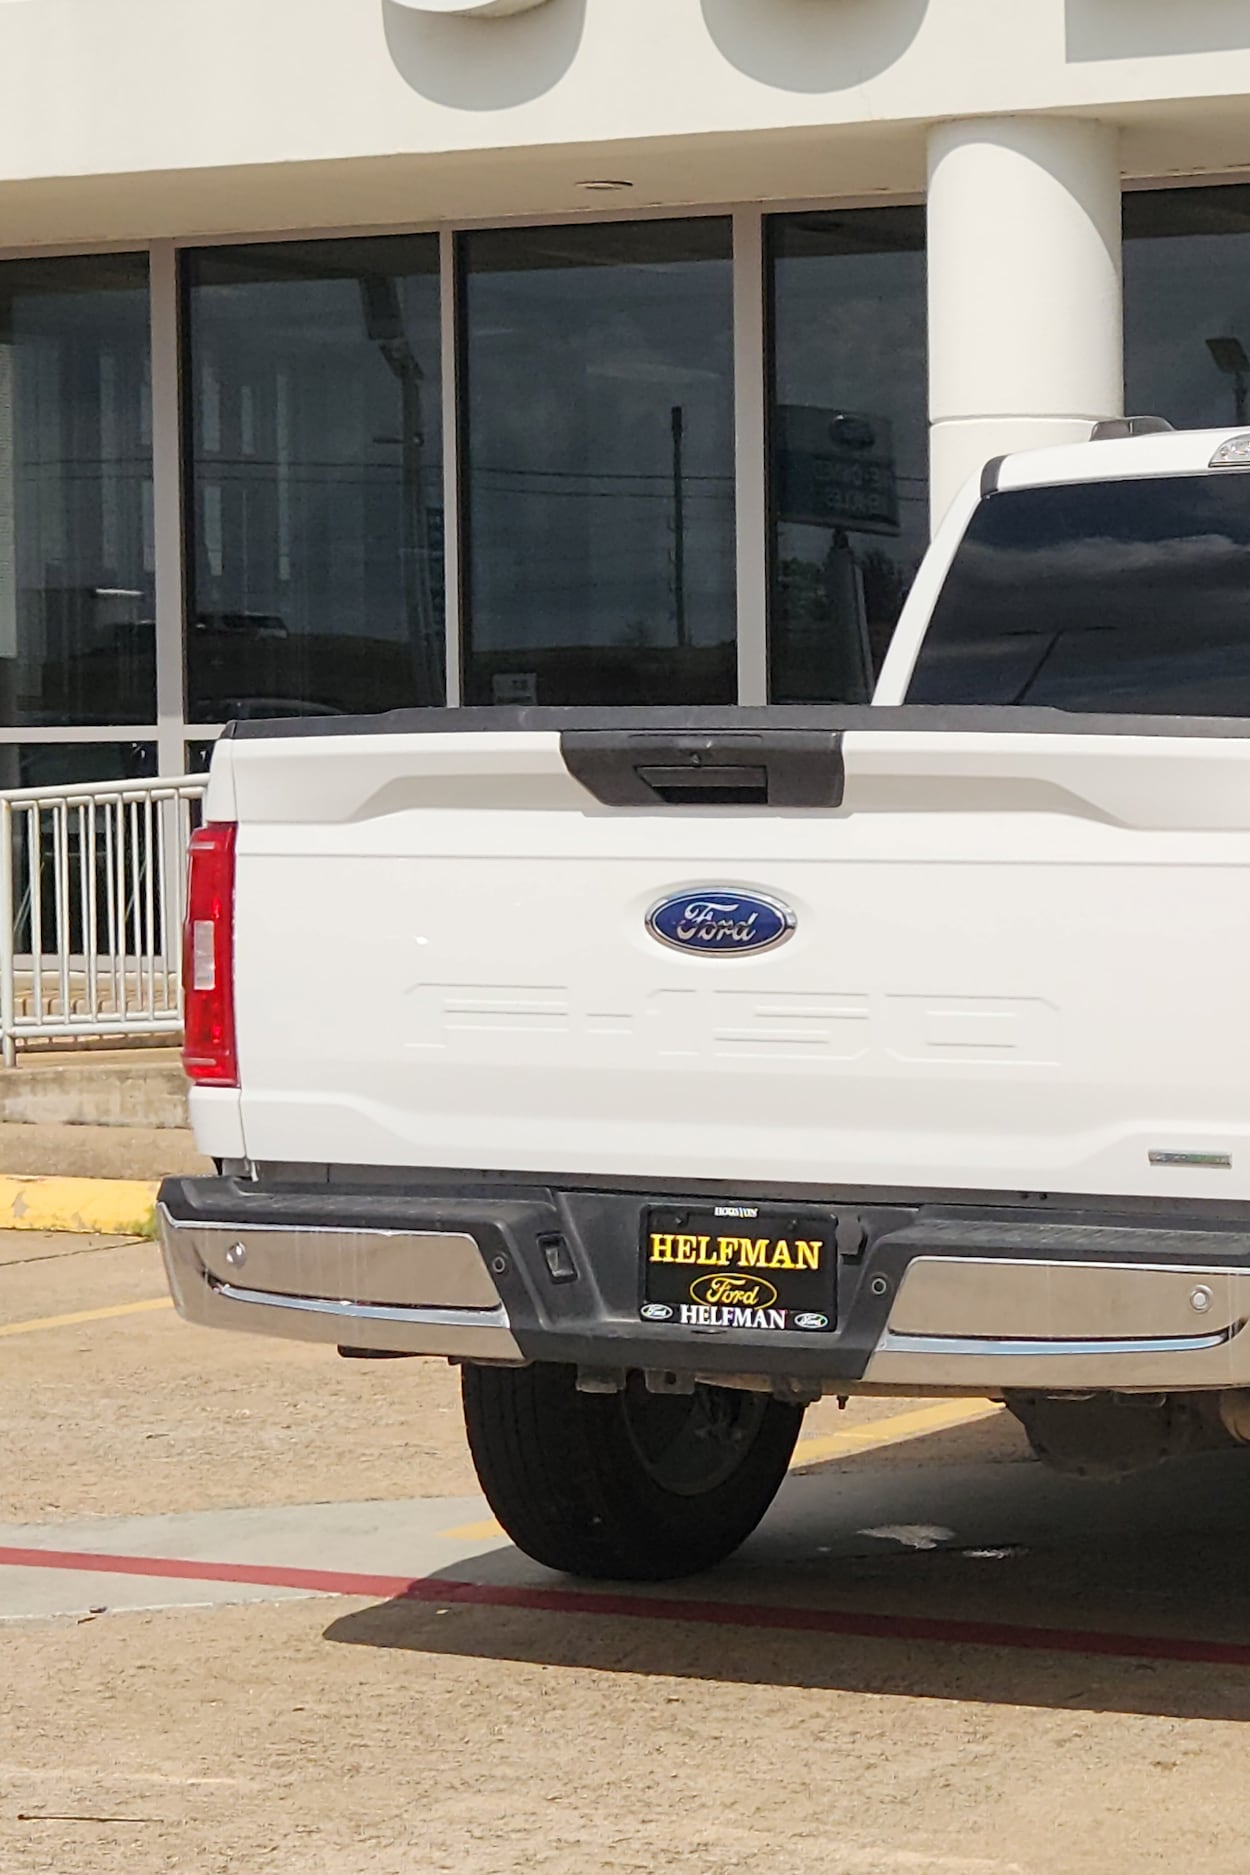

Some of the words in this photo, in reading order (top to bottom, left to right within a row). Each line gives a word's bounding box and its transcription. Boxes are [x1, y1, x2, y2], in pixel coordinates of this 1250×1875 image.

[677, 902, 759, 941] Ford
[650, 1233, 823, 1270] HELFMAN
[706, 1276, 759, 1305] Ford
[680, 1304, 787, 1329] HELFMAN
